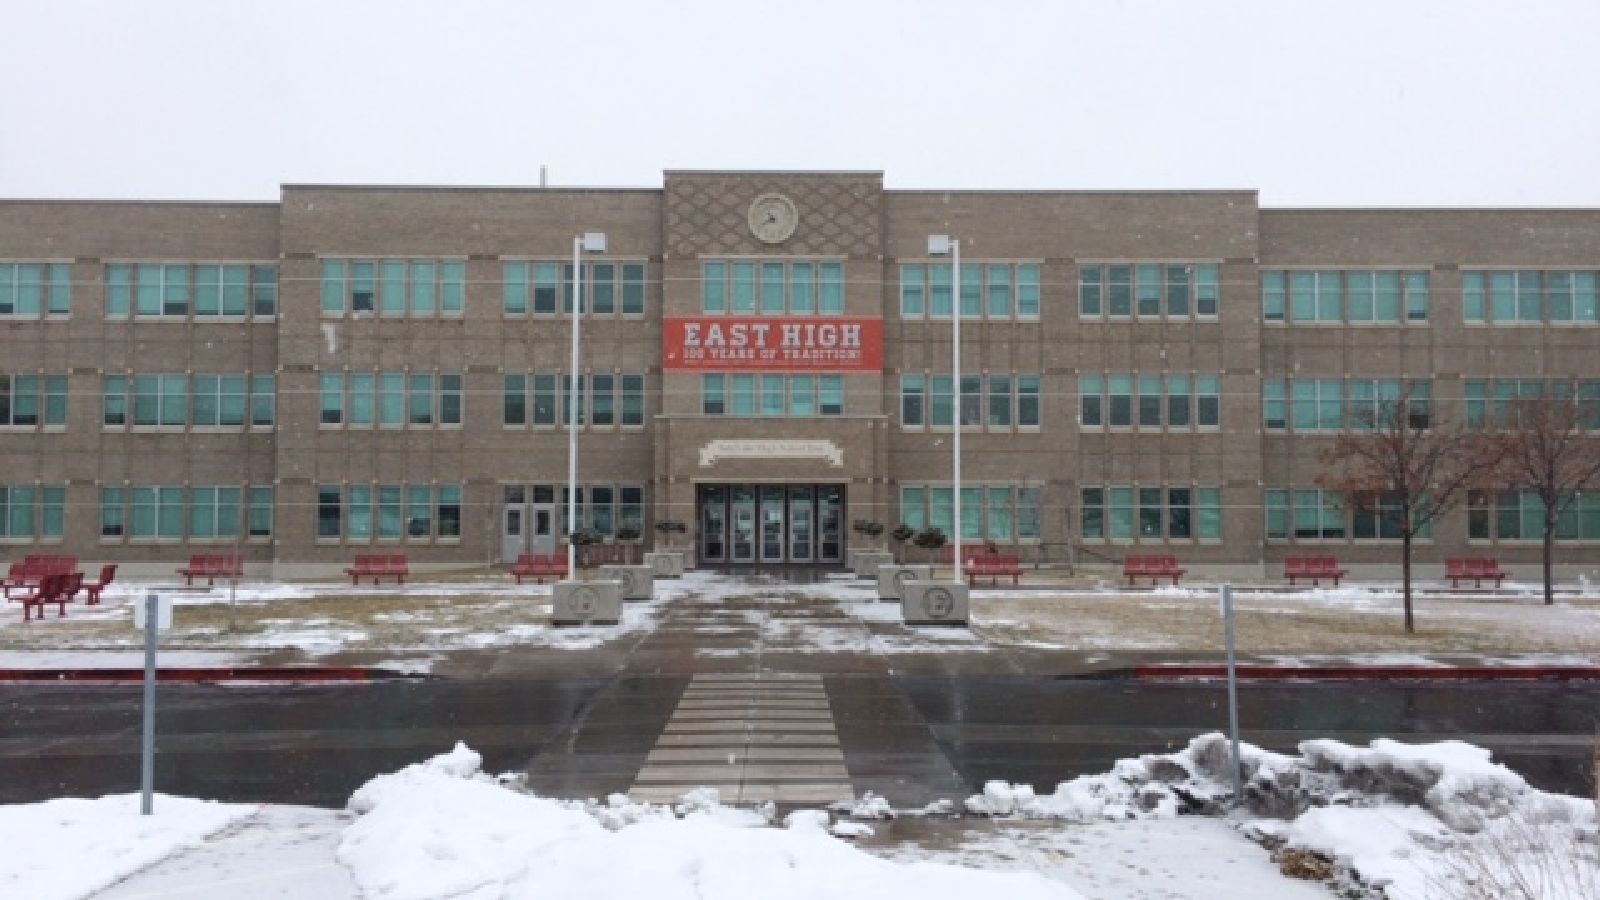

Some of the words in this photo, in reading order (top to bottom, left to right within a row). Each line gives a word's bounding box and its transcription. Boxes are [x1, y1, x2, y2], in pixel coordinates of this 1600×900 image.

[684, 322, 770, 346] EAST
[782, 323, 861, 347] HIGH
[709, 348, 755, 359] YEARS
[759, 348, 776, 360] OF
